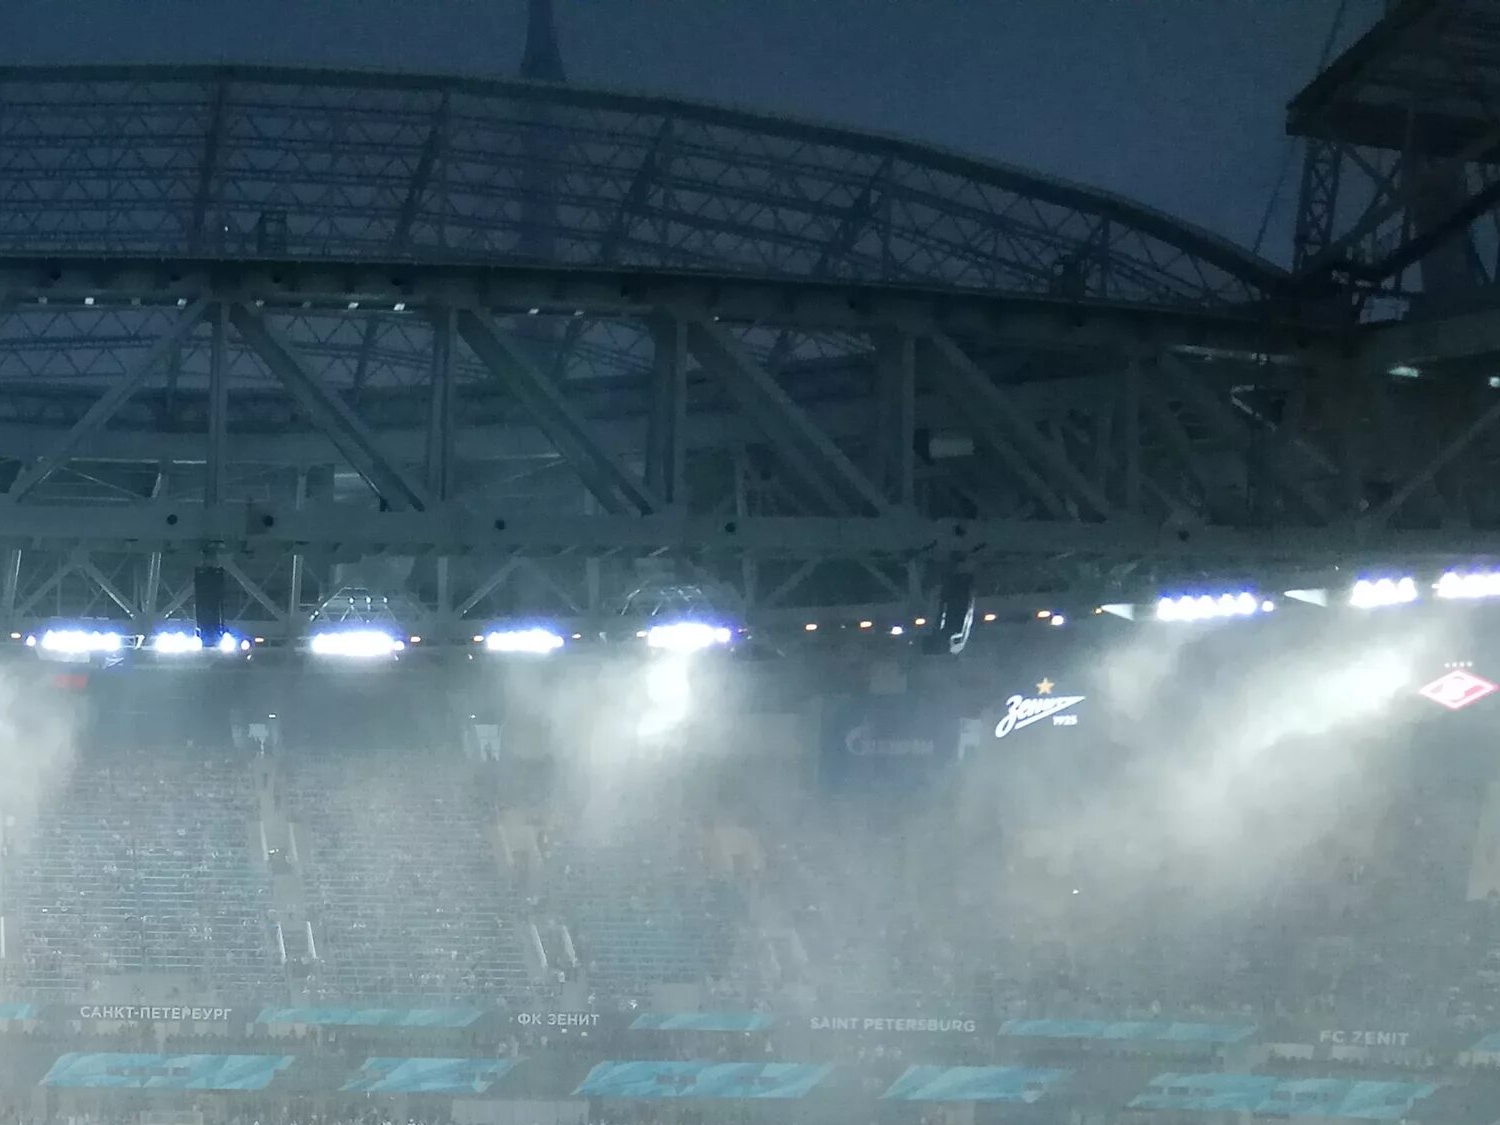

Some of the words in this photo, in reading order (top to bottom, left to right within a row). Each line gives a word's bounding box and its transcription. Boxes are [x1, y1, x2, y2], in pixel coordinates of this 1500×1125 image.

[80, 1006, 232, 1020] САНКТ-ПЕТЕРБУРГ
[517, 1012, 542, 1026] ФК
[547, 1013, 600, 1026] ЗЕНИТ
[810, 1017, 859, 1030] SAINT
[864, 1018, 976, 1033] PETERSBURG
[1320, 1030, 1345, 1043] FC
[1352, 1031, 1409, 1046] ZENIT
